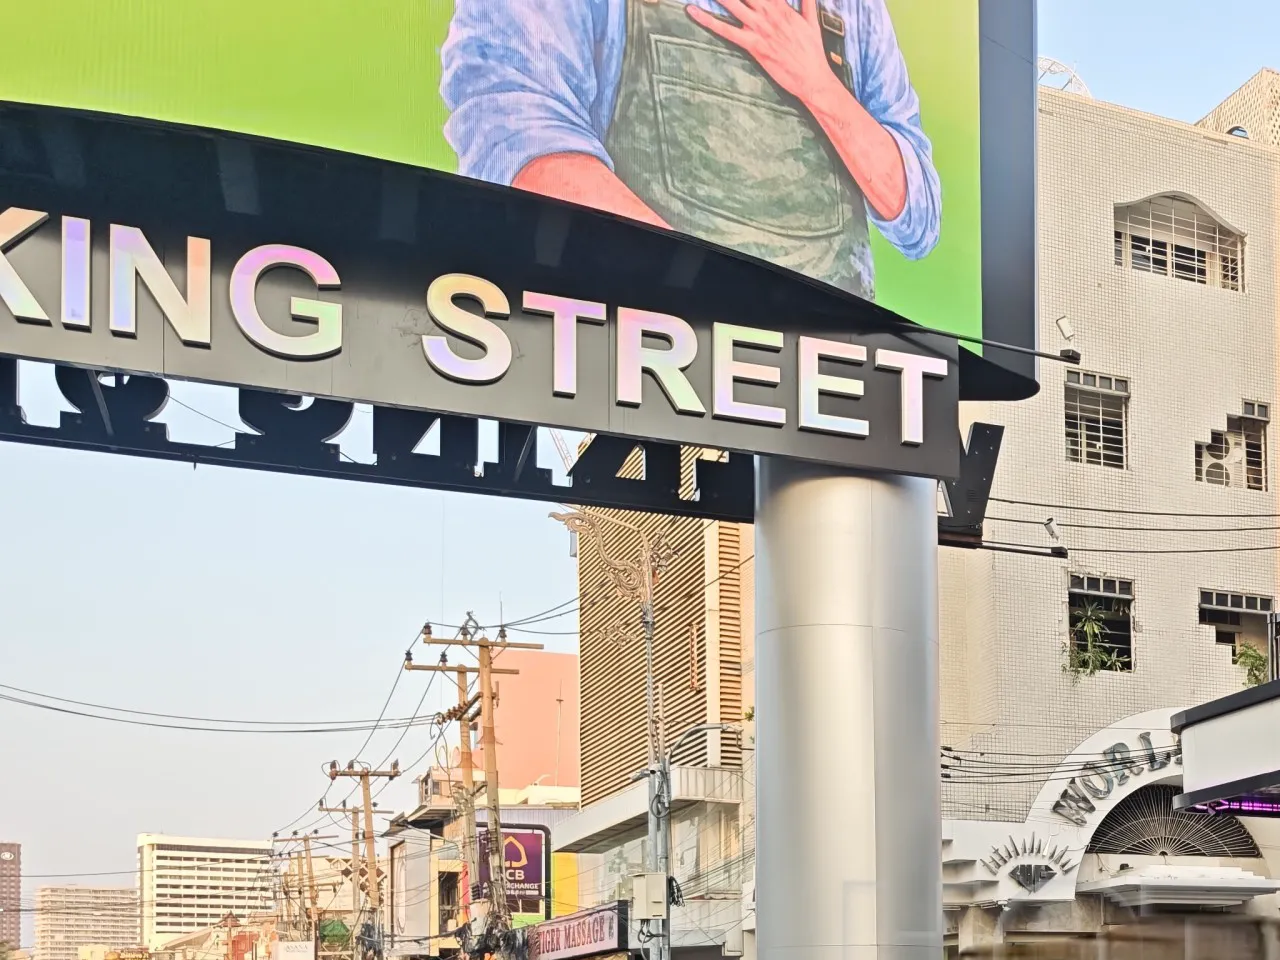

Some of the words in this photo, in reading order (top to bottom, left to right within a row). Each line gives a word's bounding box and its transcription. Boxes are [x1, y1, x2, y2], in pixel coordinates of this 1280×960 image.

[421, 272, 949, 447] STREET
[1052, 731, 1182, 826] WORL
[501, 869, 525, 881] CB
[538, 927, 561, 955] TIGER
[563, 914, 606, 950] MASSAGE
